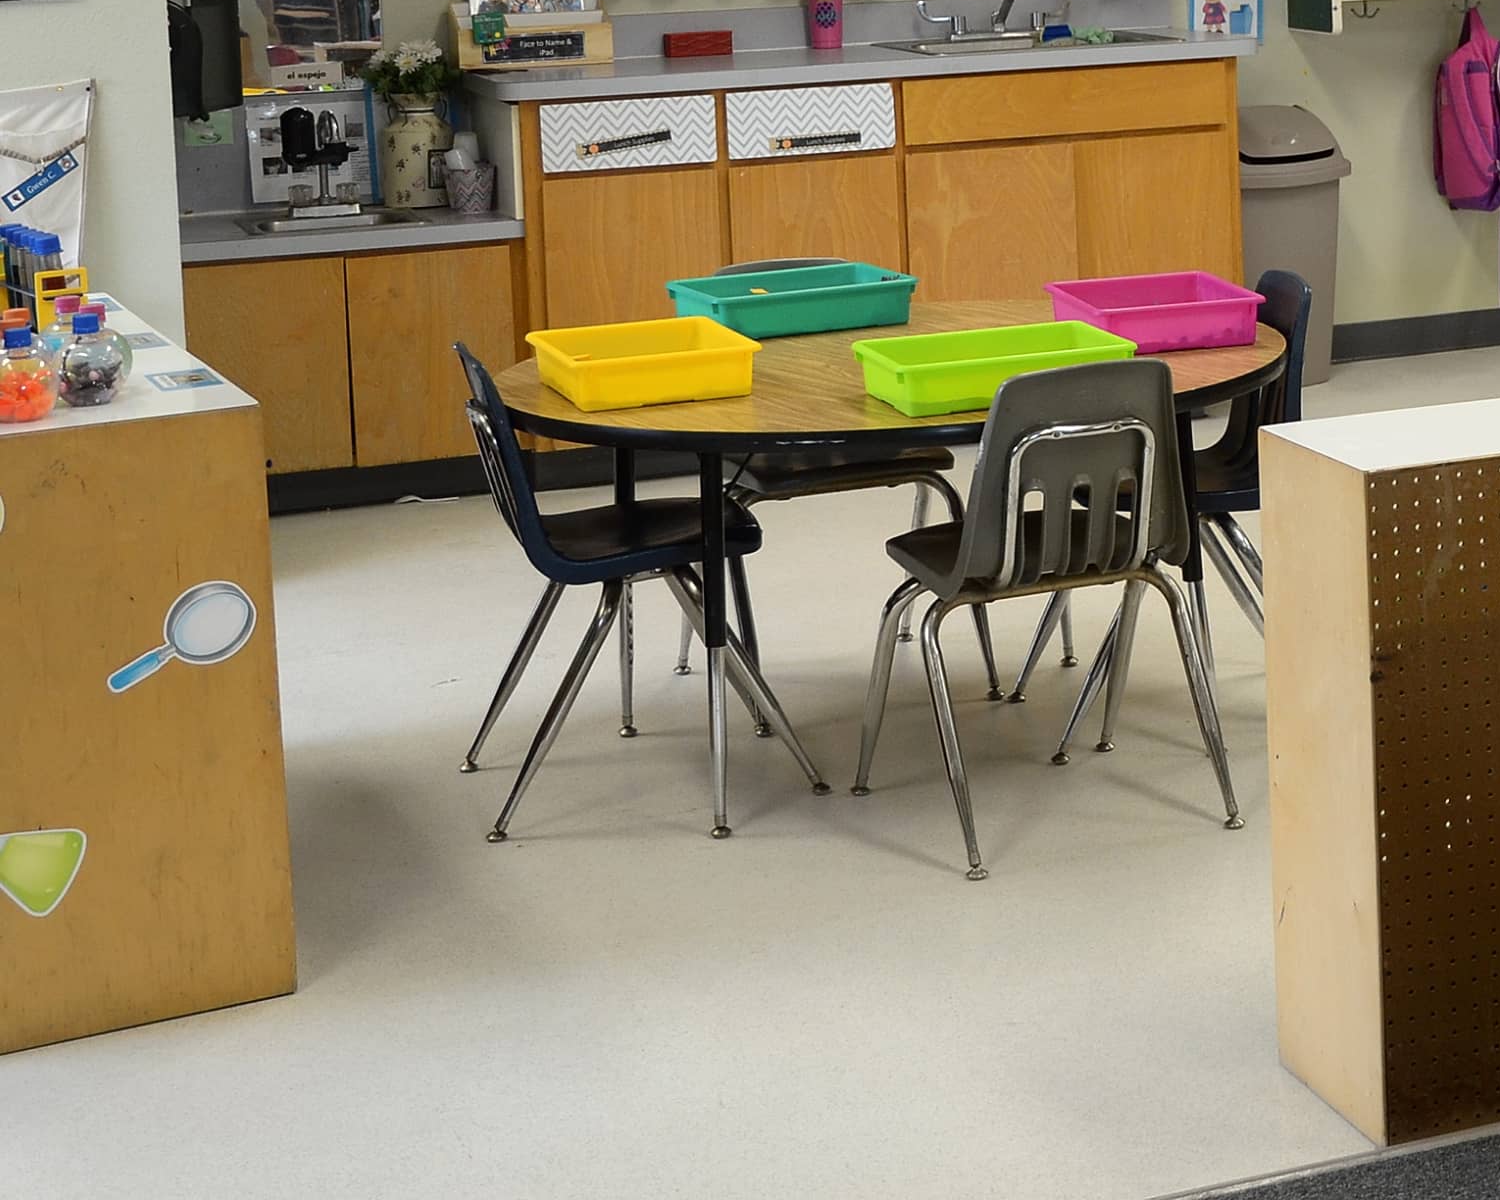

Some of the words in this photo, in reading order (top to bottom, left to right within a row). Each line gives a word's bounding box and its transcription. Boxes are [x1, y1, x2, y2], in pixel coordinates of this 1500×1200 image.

[520, 40, 535, 48] Face
[287, 71, 295, 79] el
[298, 69, 326, 79] espejo
[27, 177, 49, 193] Gwen
